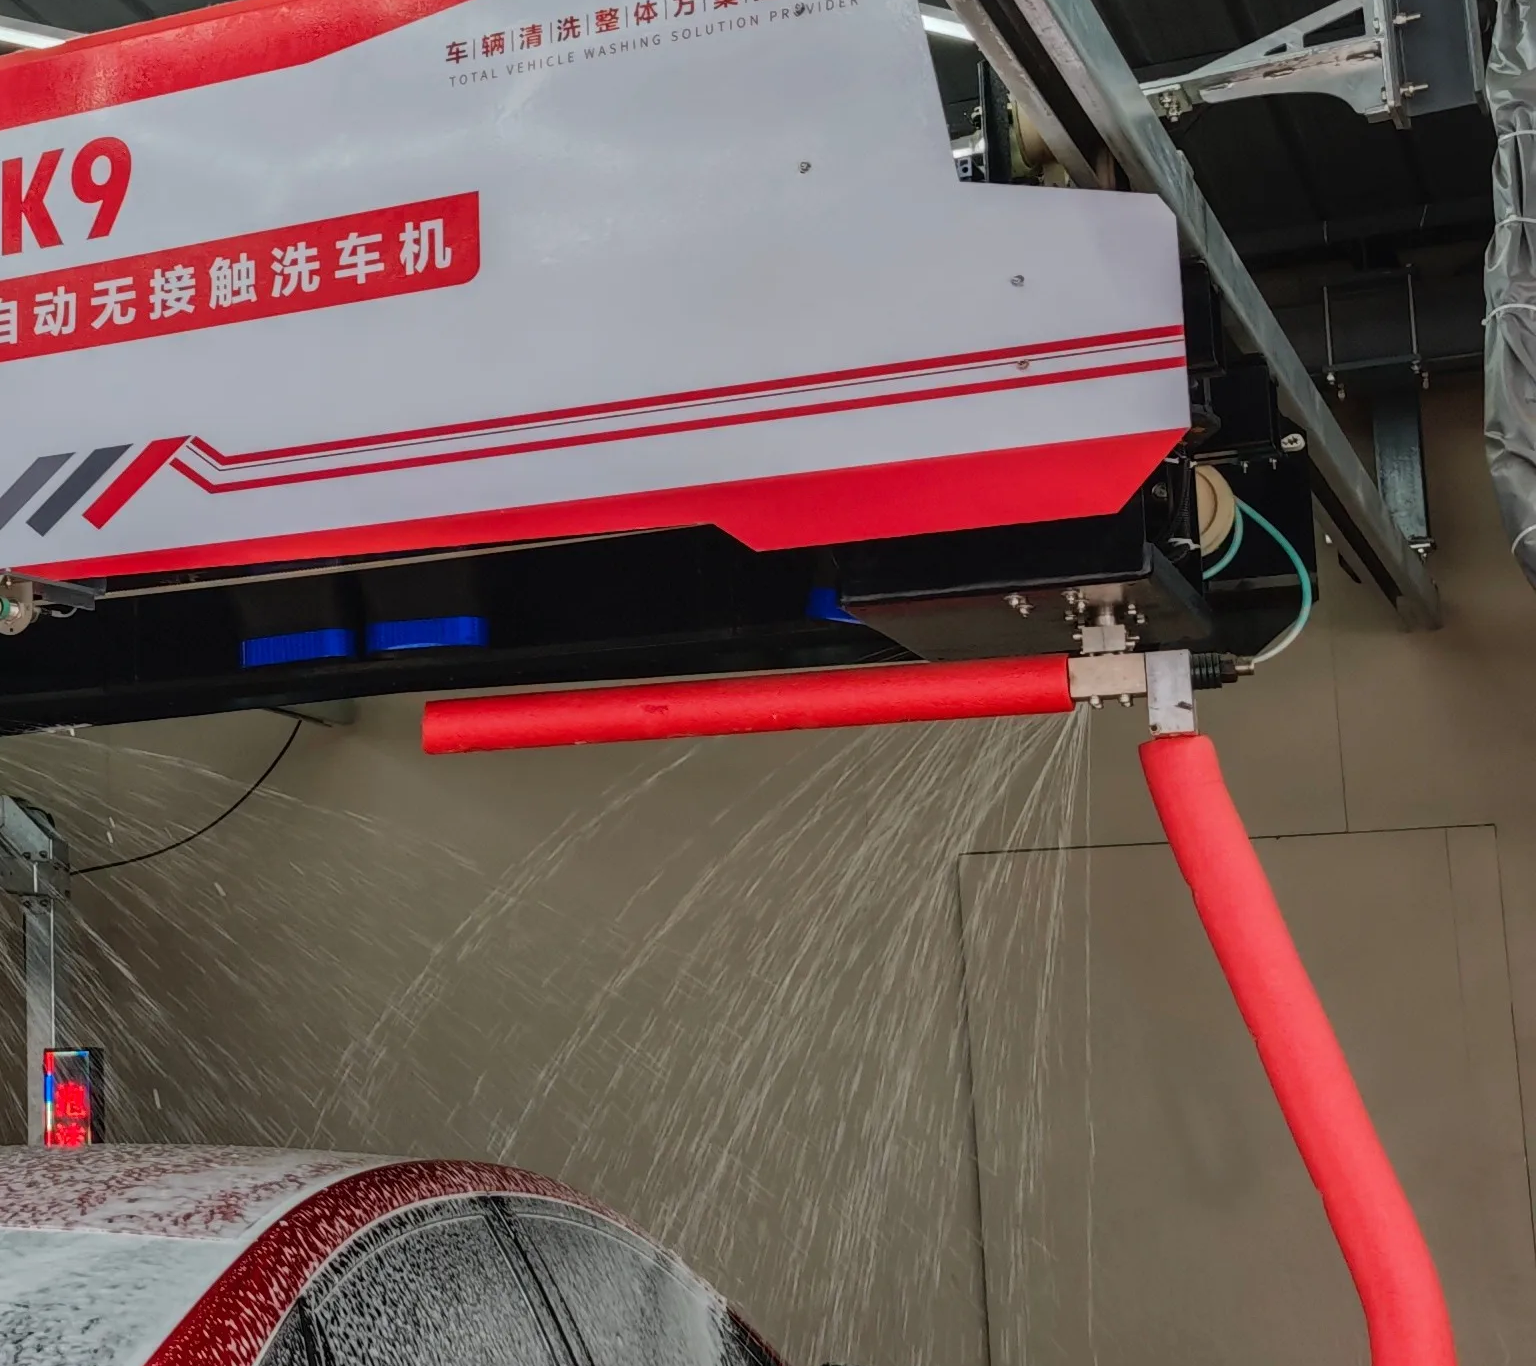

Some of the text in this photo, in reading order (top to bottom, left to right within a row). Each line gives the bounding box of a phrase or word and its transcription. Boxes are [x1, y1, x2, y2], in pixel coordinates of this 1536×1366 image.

[449, 68, 498, 87] TOTAL
[506, 52, 575, 75] VEHICLE
[584, 34, 661, 59] WASHING
[671, 14, 759, 42] SOLUTION
[2, 136, 132, 256] K9
